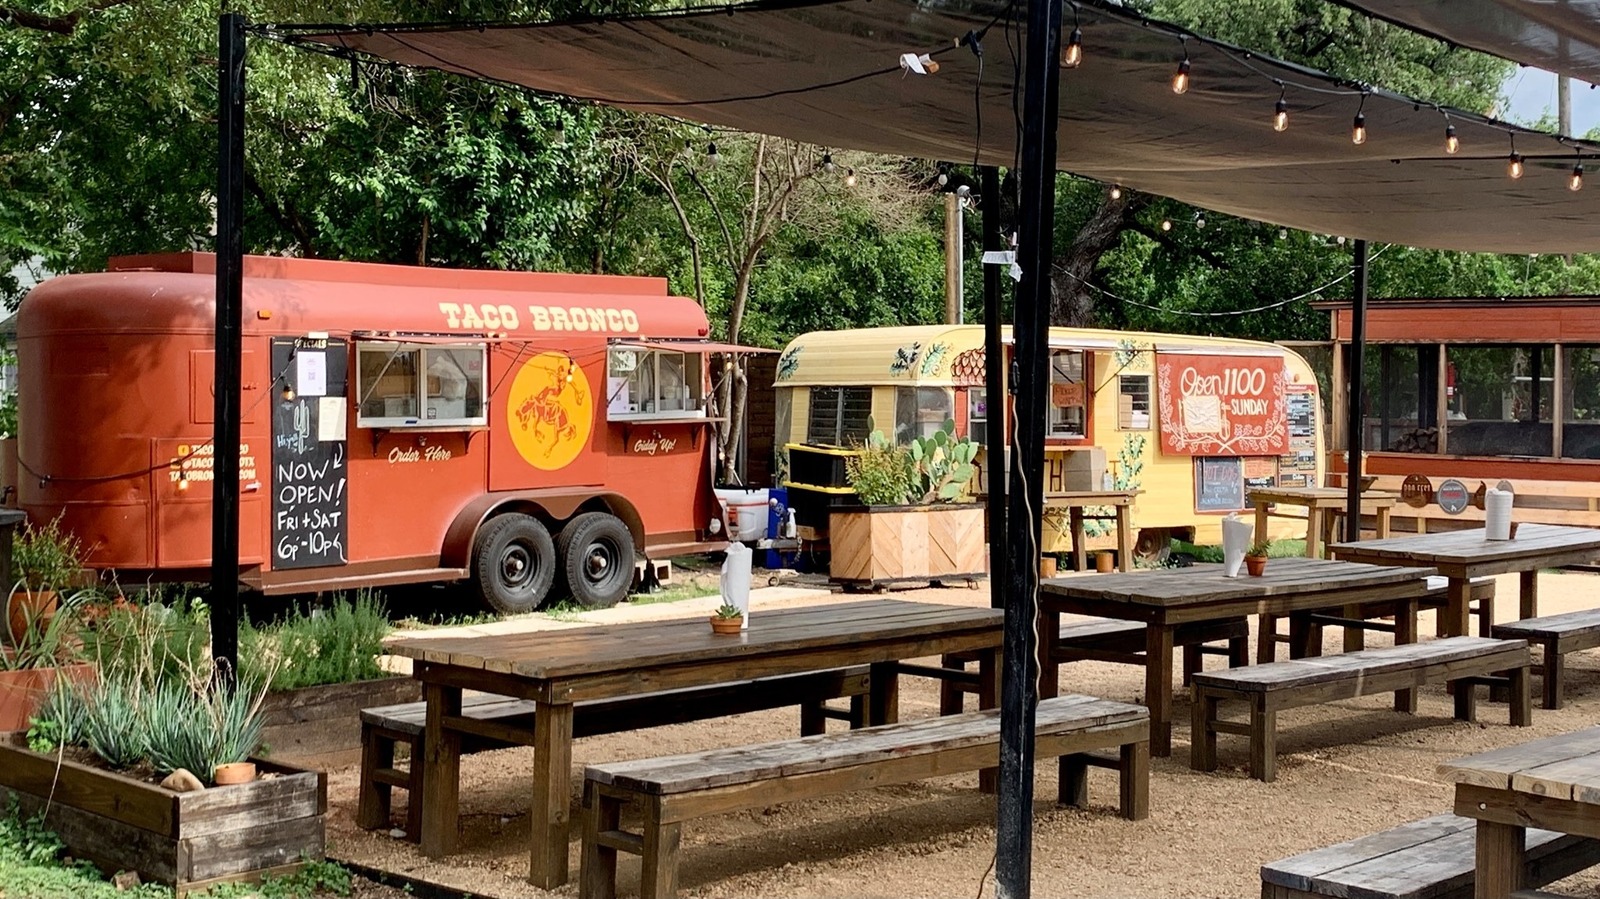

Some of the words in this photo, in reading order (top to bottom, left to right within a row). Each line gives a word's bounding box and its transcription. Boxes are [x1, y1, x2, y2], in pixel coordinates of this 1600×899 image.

[438, 302, 520, 330] TACO
[528, 305, 640, 333] BRONCO
[1180, 367, 1225, 398] Open
[1223, 367, 1266, 396] 1100
[388, 446, 420, 464] Order
[424, 445, 452, 461] Here
[634, 439, 658, 455] Giddy
[660, 438, 677, 452] Up!
[279, 459, 330, 484] NOW
[279, 477, 347, 507] OPEN!
[277, 509, 299, 531] FRI
[310, 508, 342, 529] SAT
